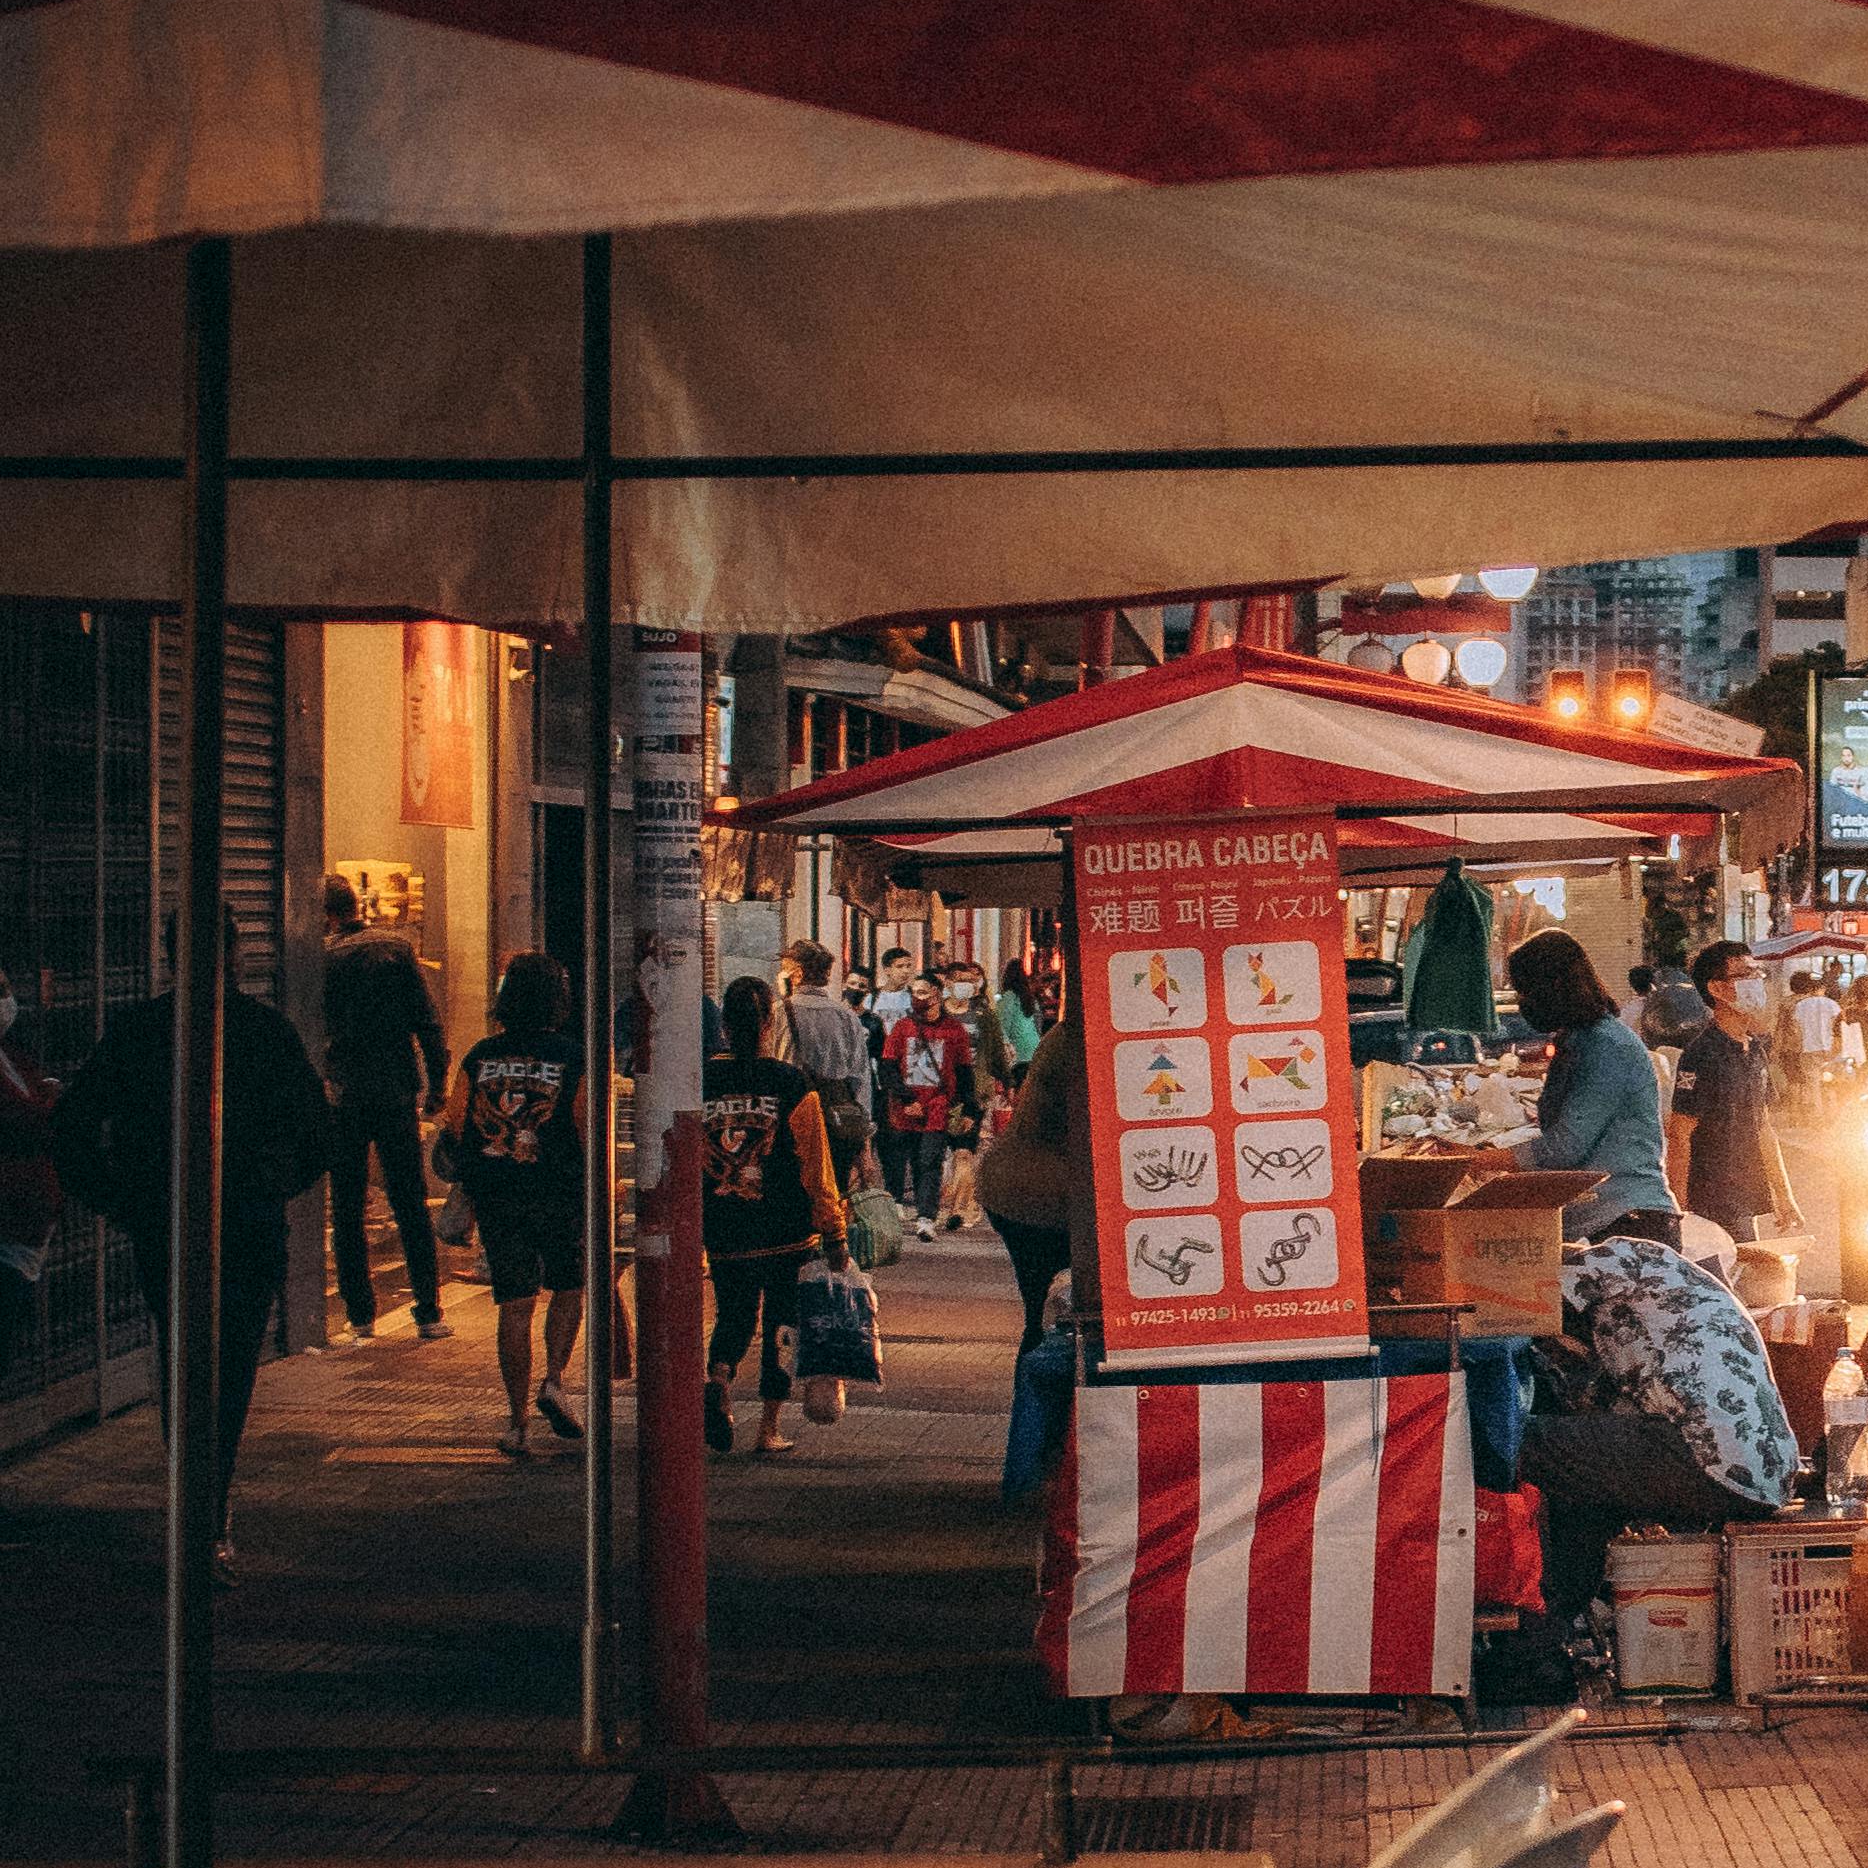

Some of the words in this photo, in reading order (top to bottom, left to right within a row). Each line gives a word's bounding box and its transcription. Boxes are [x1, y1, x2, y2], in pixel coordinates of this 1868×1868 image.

[1832, 829, 1840, 839] e
[1084, 839, 1205, 875] QUEBRA
[1213, 832, 1329, 869] CABEÇA
[1089, 899, 1161, 935] 难题
[1175, 895, 1240, 930] 퍼즐
[1254, 895, 1333, 922] パズル
[477, 1061, 561, 1087] EAGLE
[701, 1094, 779, 1122] EAGLE
[1130, 1306, 1217, 1326] 97425-1493
[1254, 1299, 1339, 1319] 95359-2264
